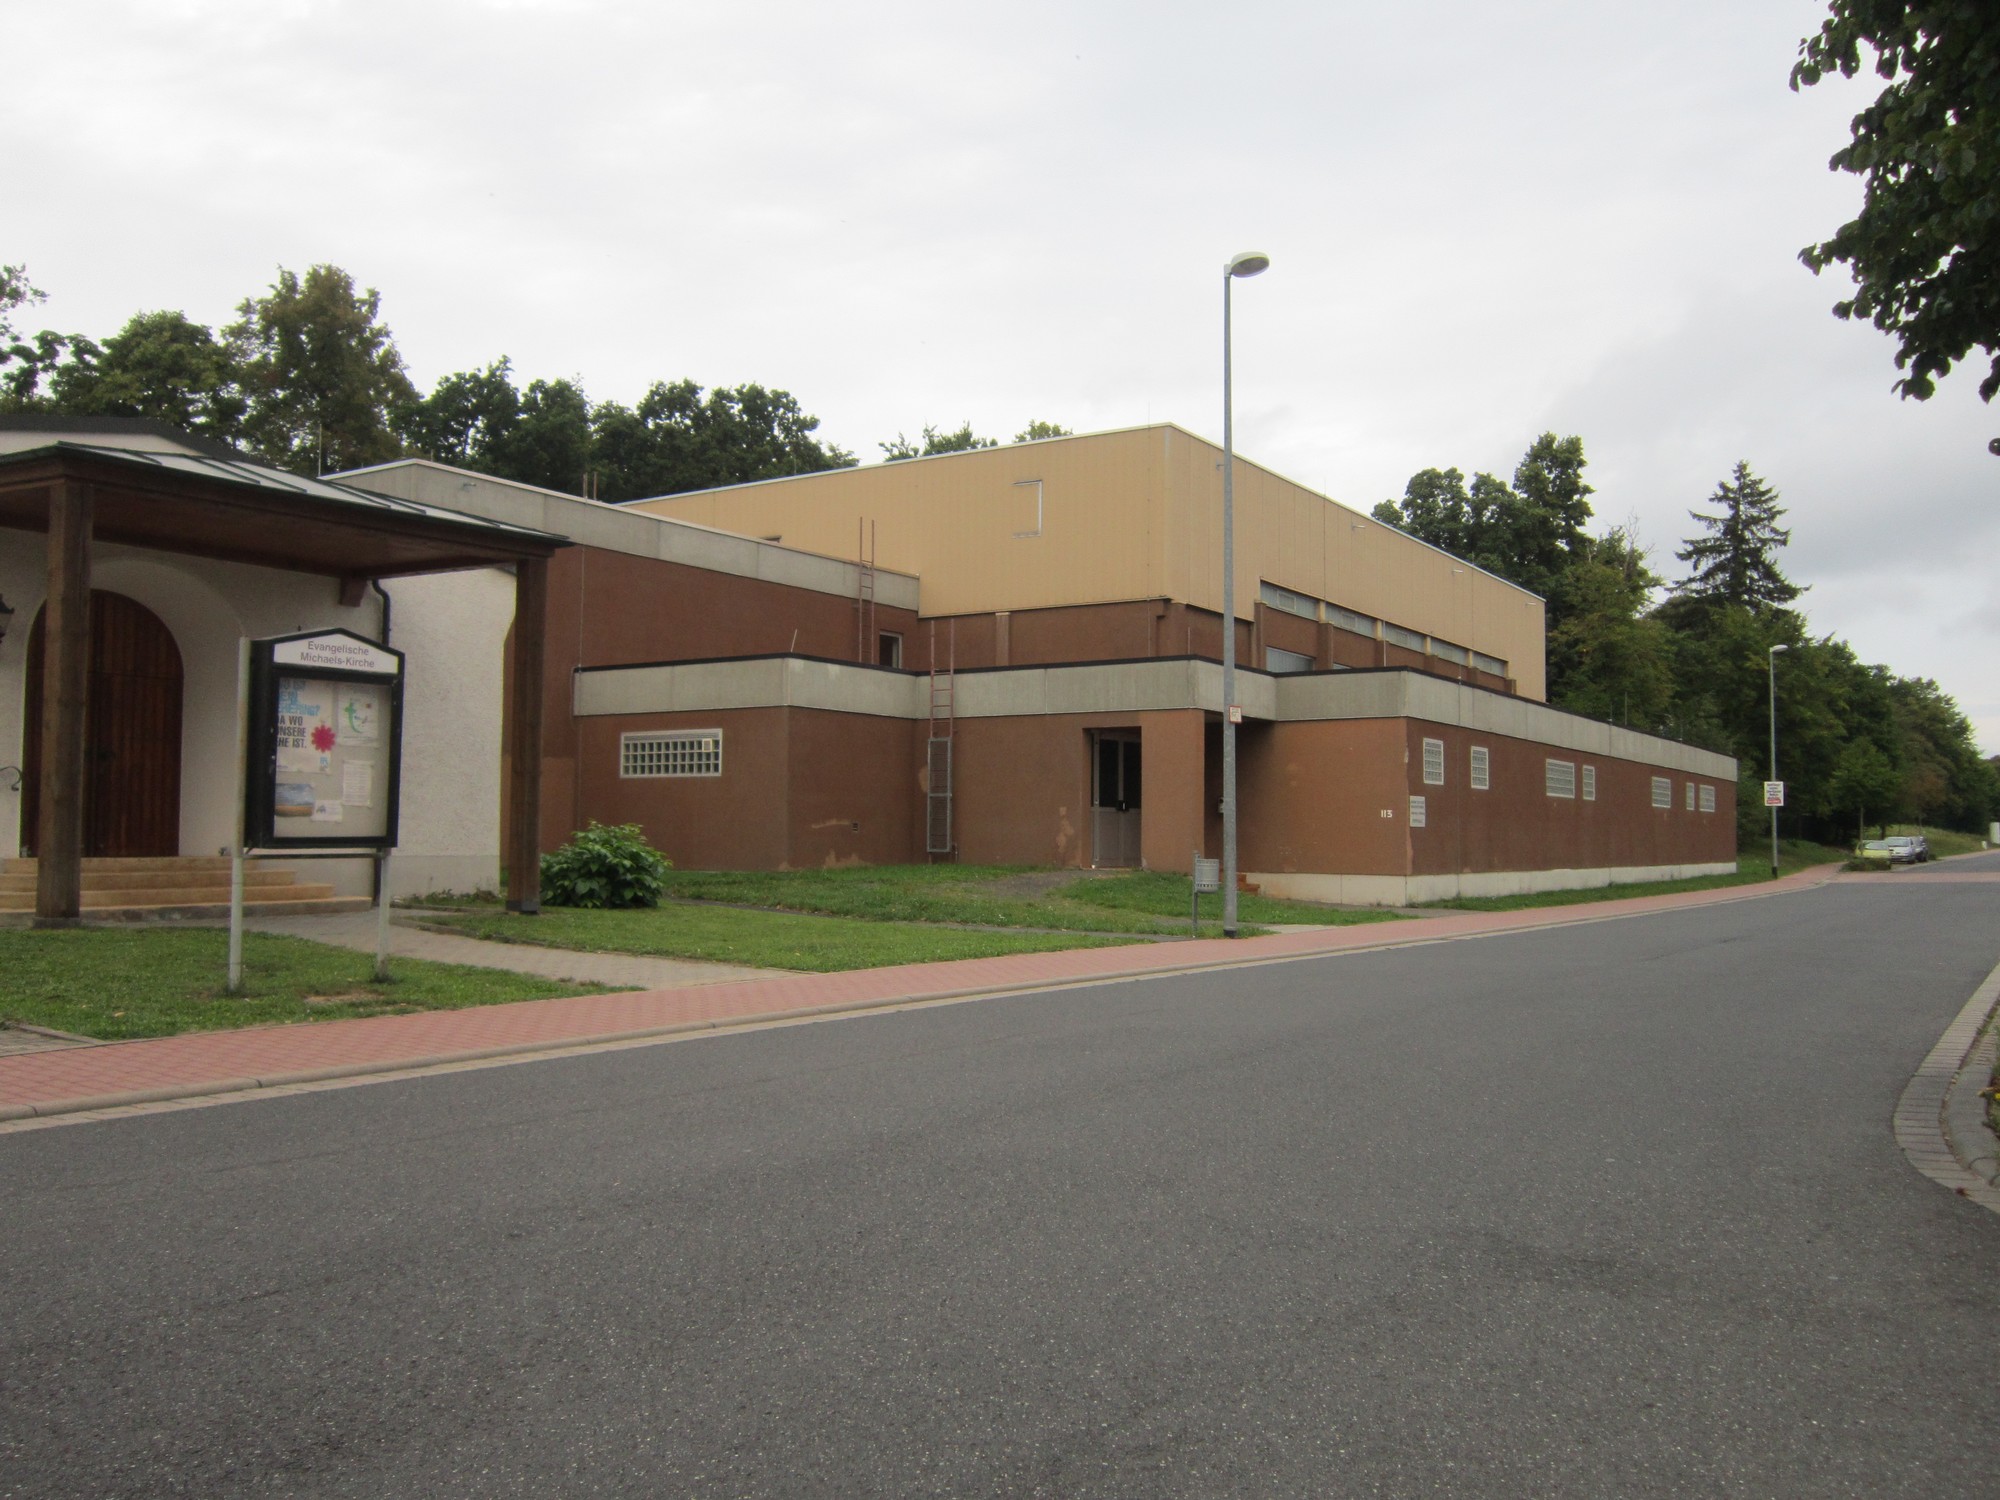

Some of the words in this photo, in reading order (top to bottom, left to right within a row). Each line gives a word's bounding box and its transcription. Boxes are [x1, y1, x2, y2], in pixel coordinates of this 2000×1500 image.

[308, 641, 369, 655] Evangelische
[300, 652, 375, 668] Michaels-Kirche
[289, 715, 304, 726] WO
[278, 726, 307, 737] NSERE
[277, 737, 289, 748] HE
